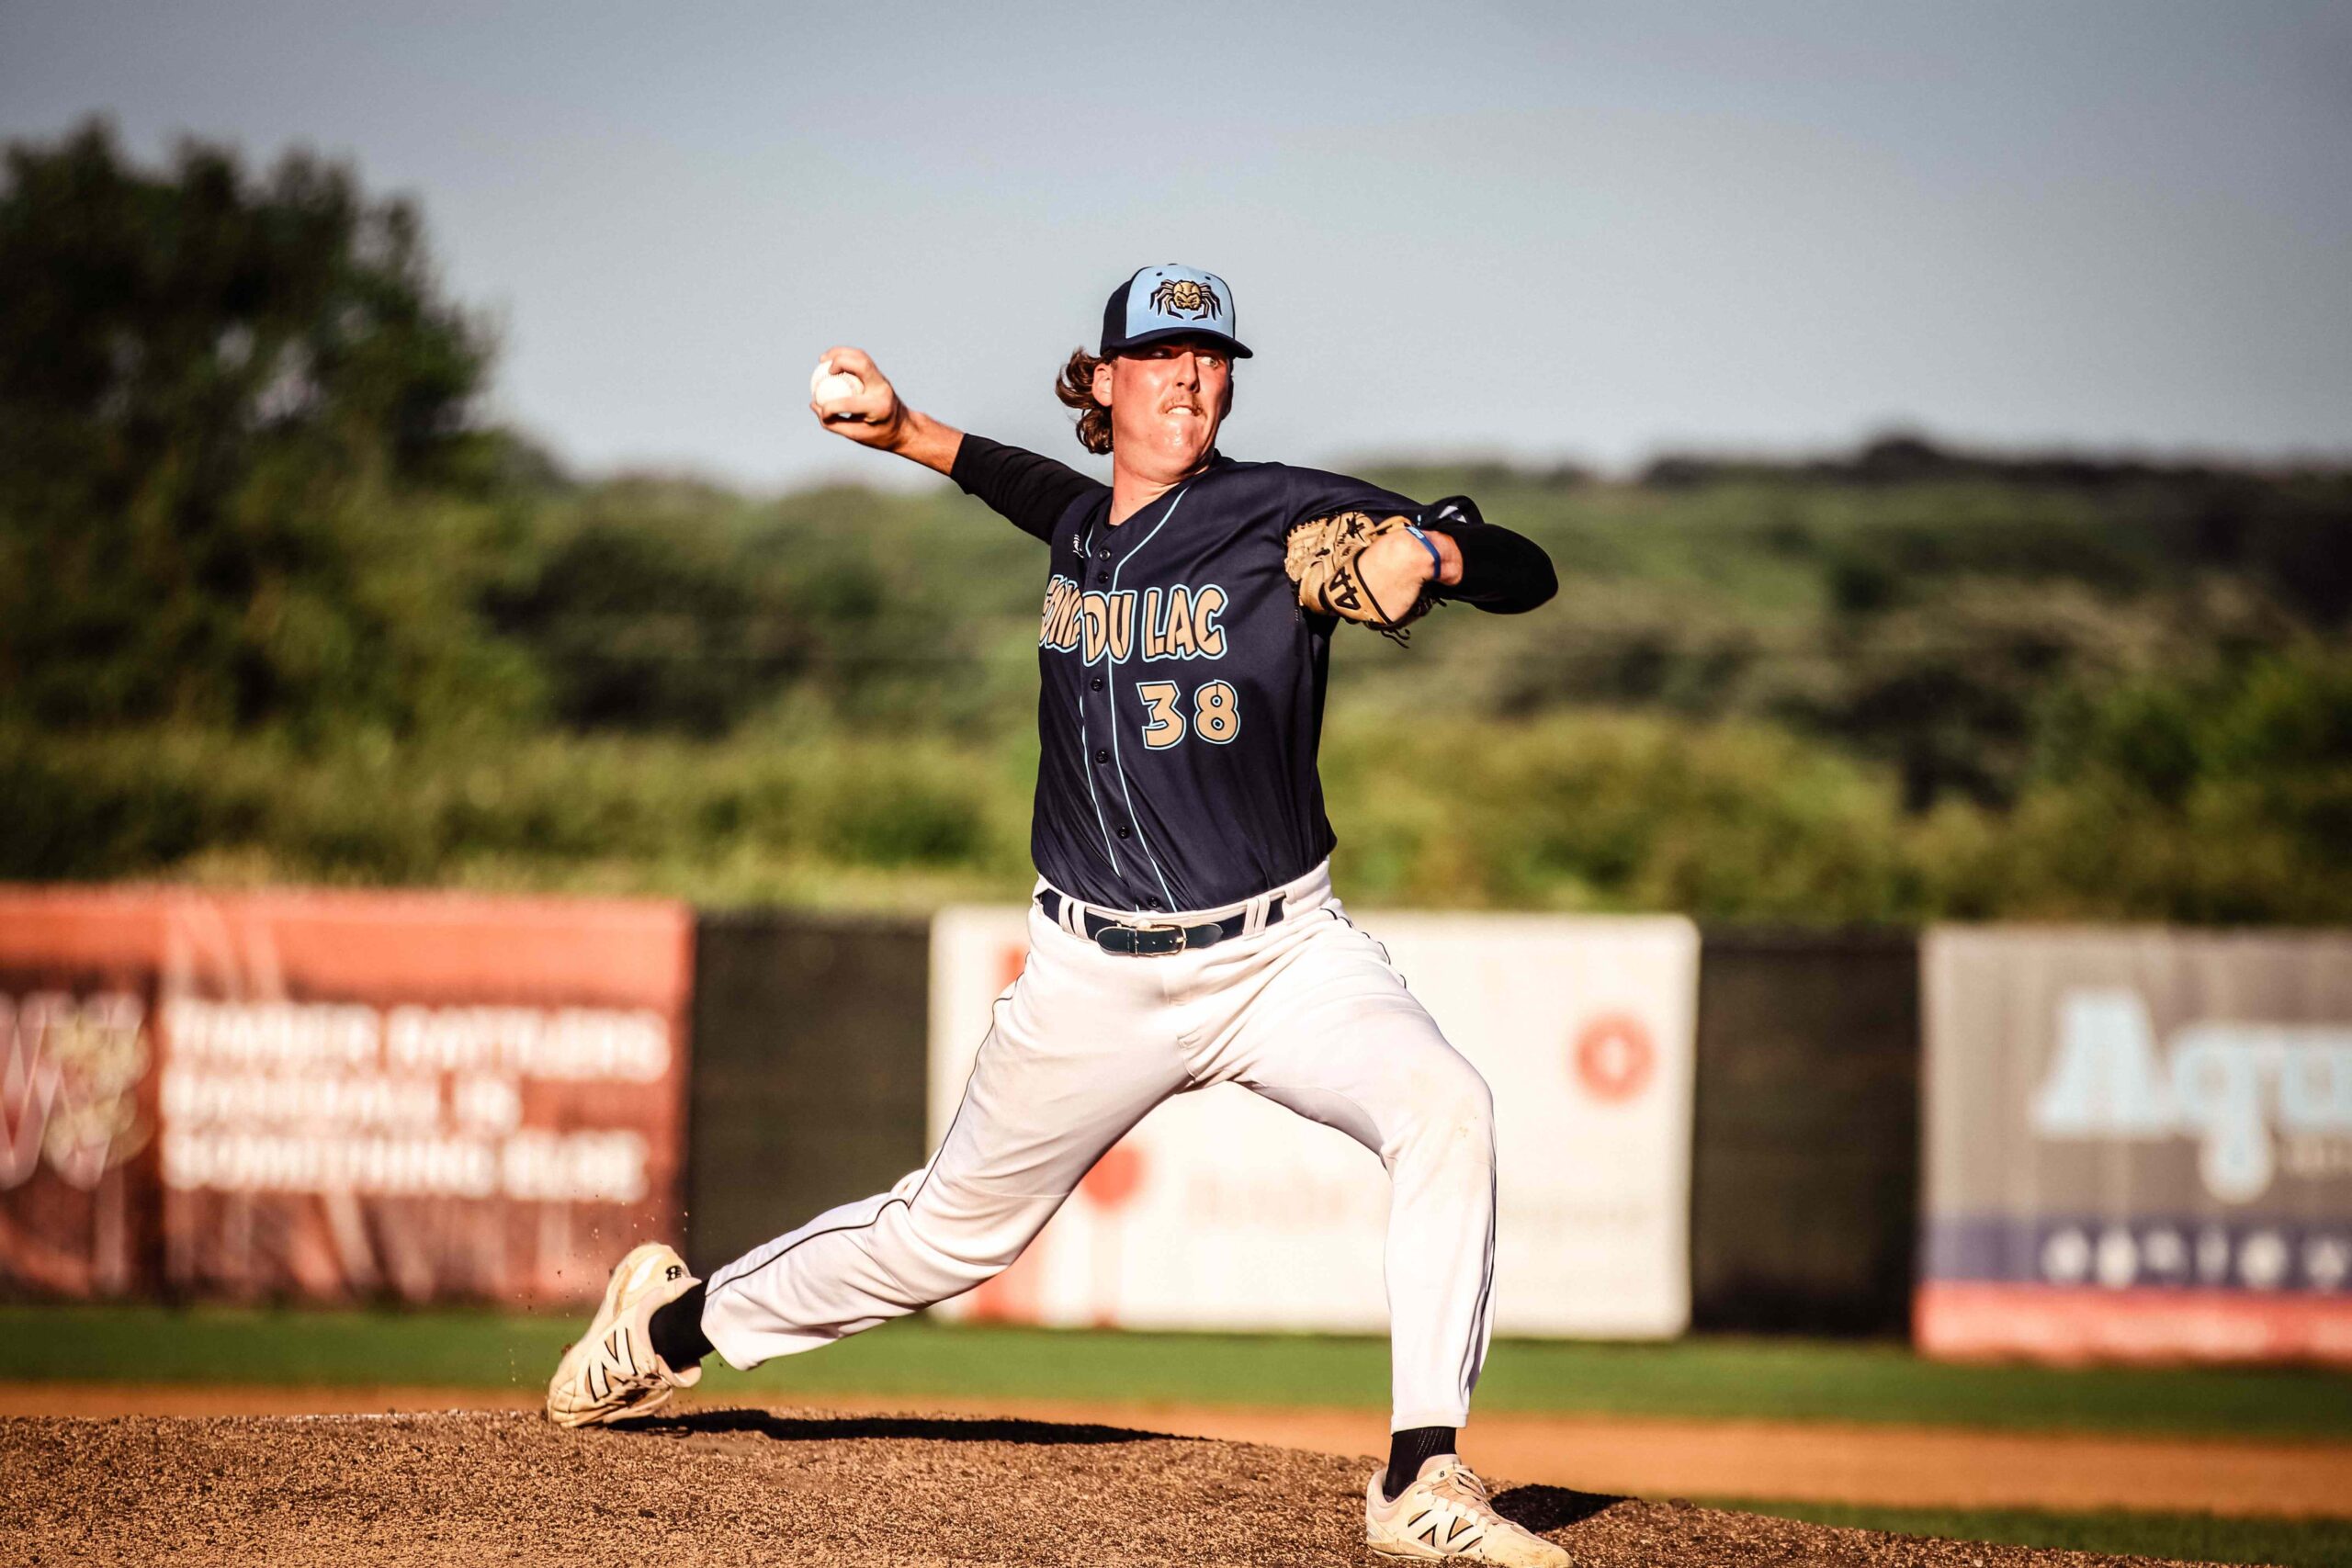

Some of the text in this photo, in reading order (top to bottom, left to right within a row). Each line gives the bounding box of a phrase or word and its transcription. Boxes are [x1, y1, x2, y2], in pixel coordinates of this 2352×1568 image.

[1082, 591, 1137, 667] DU
[1141, 584, 1228, 662] LAC
[1136, 679, 1240, 750] 38
